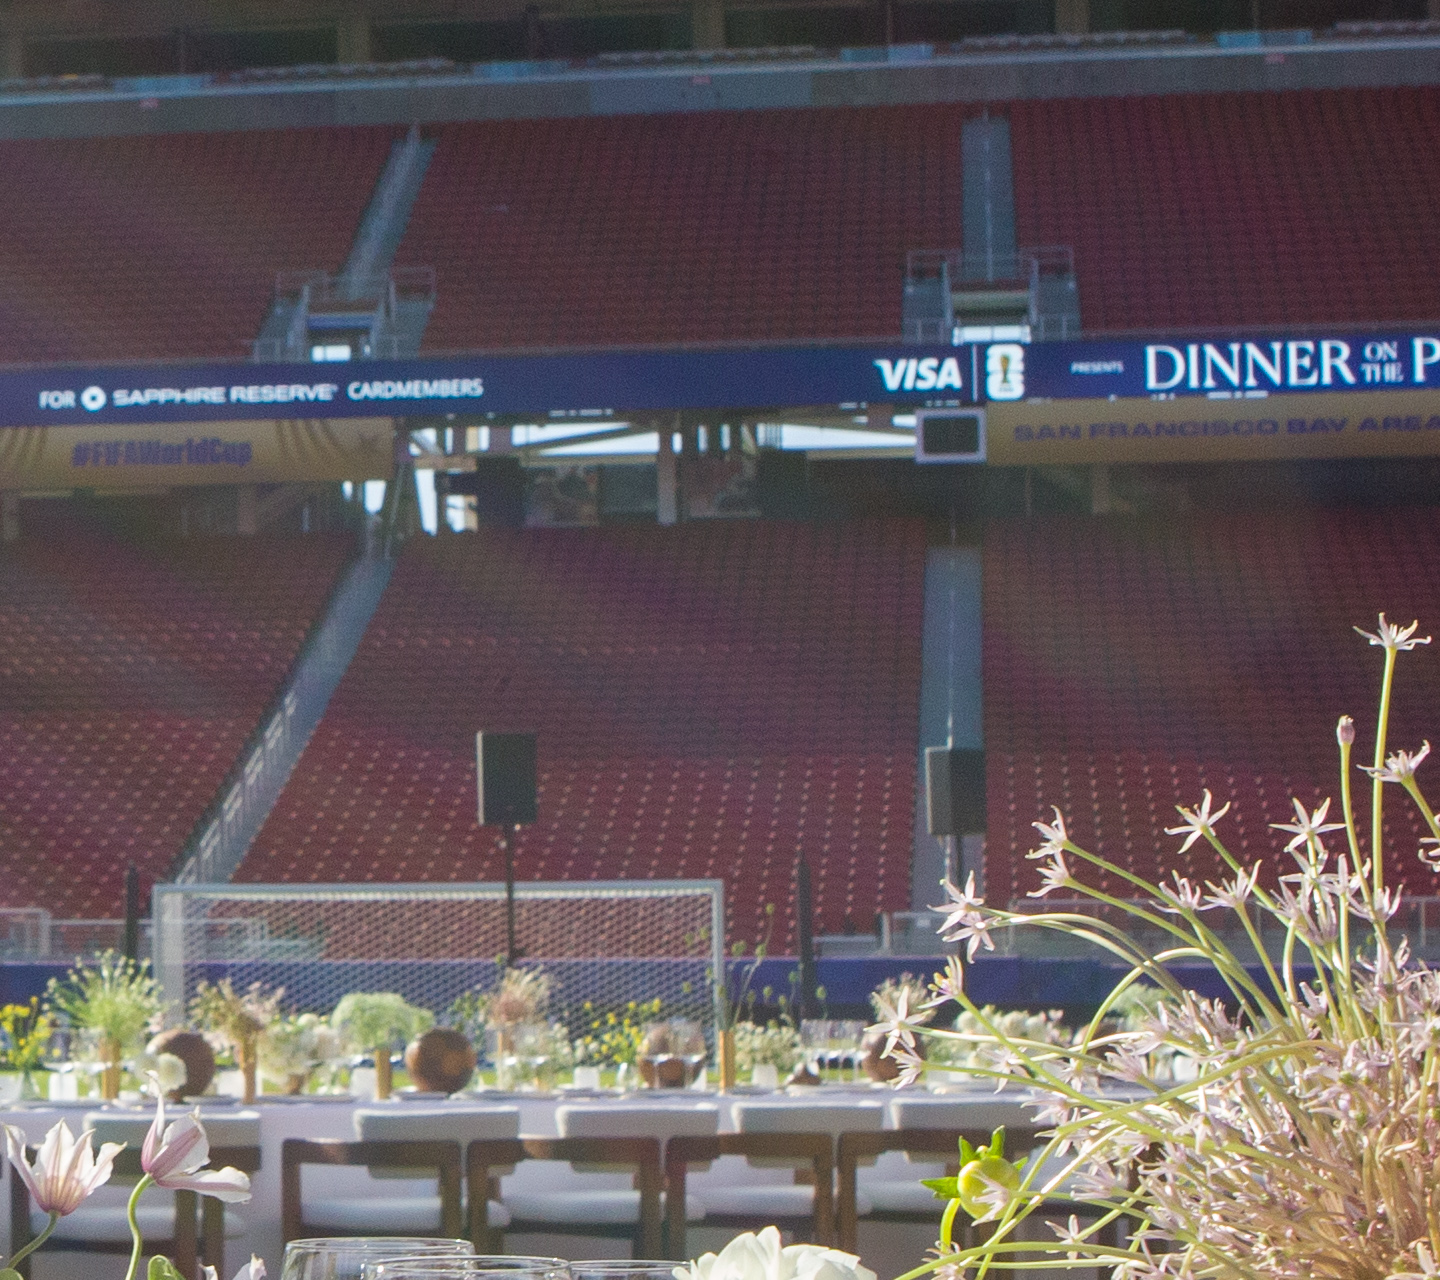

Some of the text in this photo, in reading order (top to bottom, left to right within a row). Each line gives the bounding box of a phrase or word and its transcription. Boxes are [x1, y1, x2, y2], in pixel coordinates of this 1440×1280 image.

[1363, 341, 1399, 361] ON
[874, 357, 962, 391] VISA
[1145, 340, 1353, 391] DINNER
[1361, 362, 1404, 384] THE
[39, 390, 75, 409] FOR
[113, 387, 226, 406] SAPPHIRE
[347, 378, 484, 401] CARDMEMBERS
[1013, 423, 1082, 441] SAN
[1089, 419, 1280, 440] FRANCISCO
[1287, 416, 1348, 435] BAY
